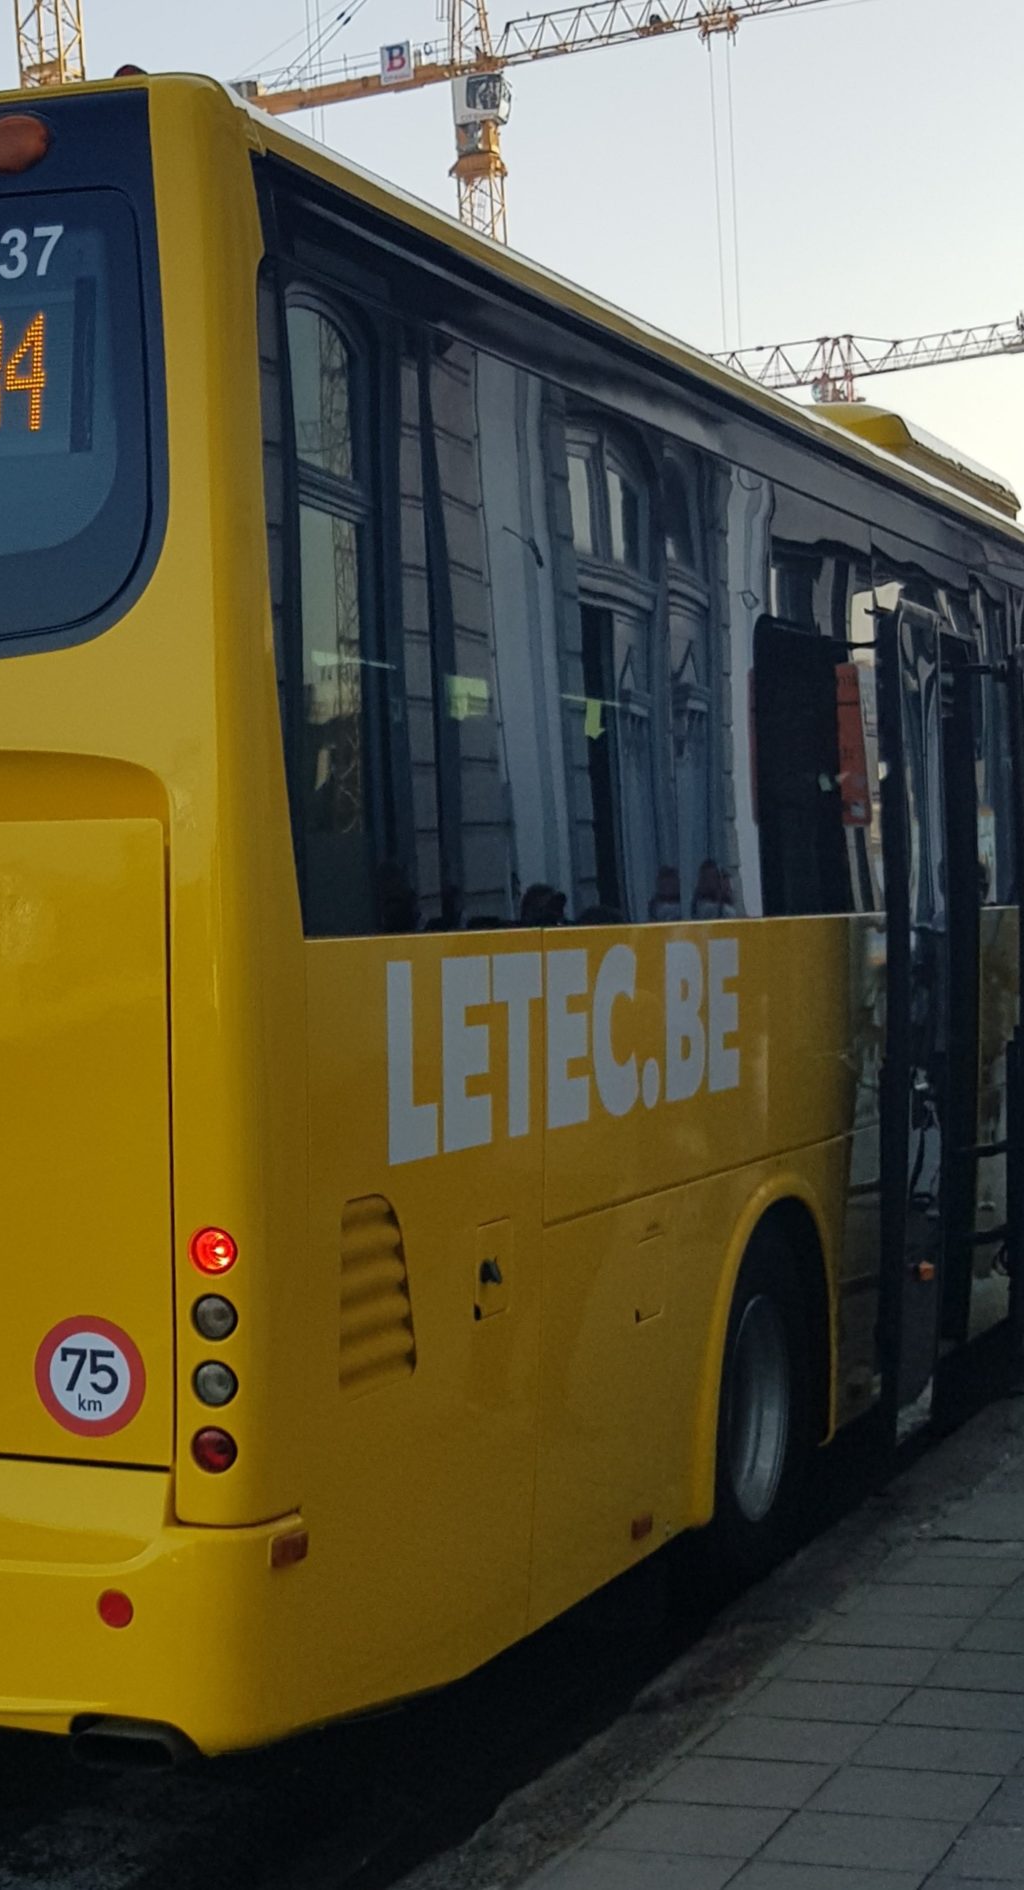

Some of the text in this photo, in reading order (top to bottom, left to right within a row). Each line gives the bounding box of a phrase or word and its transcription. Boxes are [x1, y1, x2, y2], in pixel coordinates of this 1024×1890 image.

[386, 44, 406, 72] B
[386, 938, 740, 1166] LETEC.BE
[60, 1347, 119, 1394] 75
[78, 1393, 102, 1412] km
